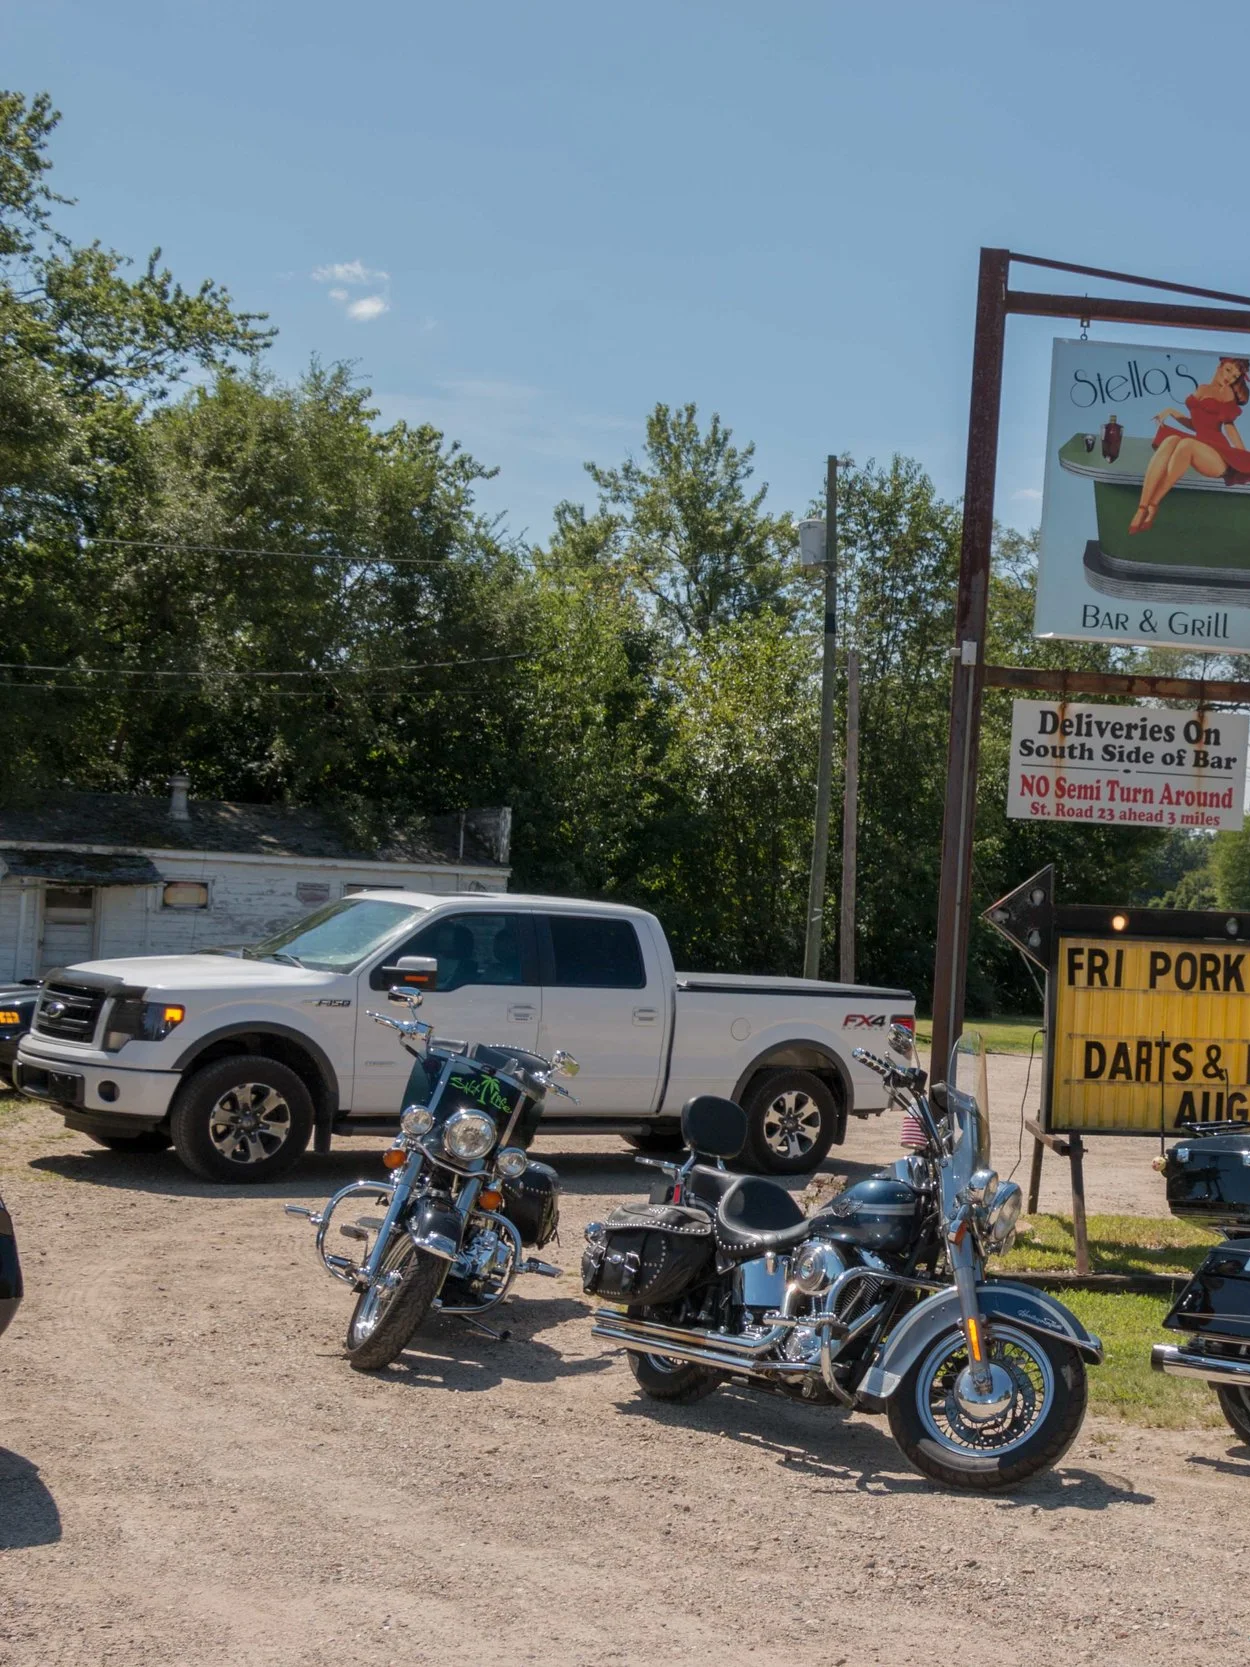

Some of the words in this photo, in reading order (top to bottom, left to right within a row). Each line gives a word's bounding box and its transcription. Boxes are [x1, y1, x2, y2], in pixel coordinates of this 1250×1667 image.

[1069, 354, 1199, 408] Stella's
[1138, 608, 1158, 634] &
[1037, 710, 1176, 744] Deliveries
[1183, 719, 1222, 746] On
[1019, 738, 1095, 762] South
[1101, 743, 1155, 765] Side
[1161, 749, 1186, 767] of
[1192, 750, 1238, 770] Bar
[1019, 773, 1050, 798] NO
[1054, 775, 1101, 802] Semi
[1106, 780, 1155, 804] Turn
[1159, 782, 1234, 809] Around
[1030, 801, 1051, 816] St.
[1055, 803, 1094, 819] Road
[1097, 808, 1115, 821] 23
[1119, 807, 1164, 824] ahead
[1167, 812, 1177, 826] 3
[1180, 811, 1221, 827] miles
[1066, 947, 1124, 988] FRI
[1149, 951, 1246, 993] PORK
[843, 1014, 887, 1027] FX4
[1084, 1041, 1194, 1082] DARTS
[1174, 1090, 1249, 1128] AUG
